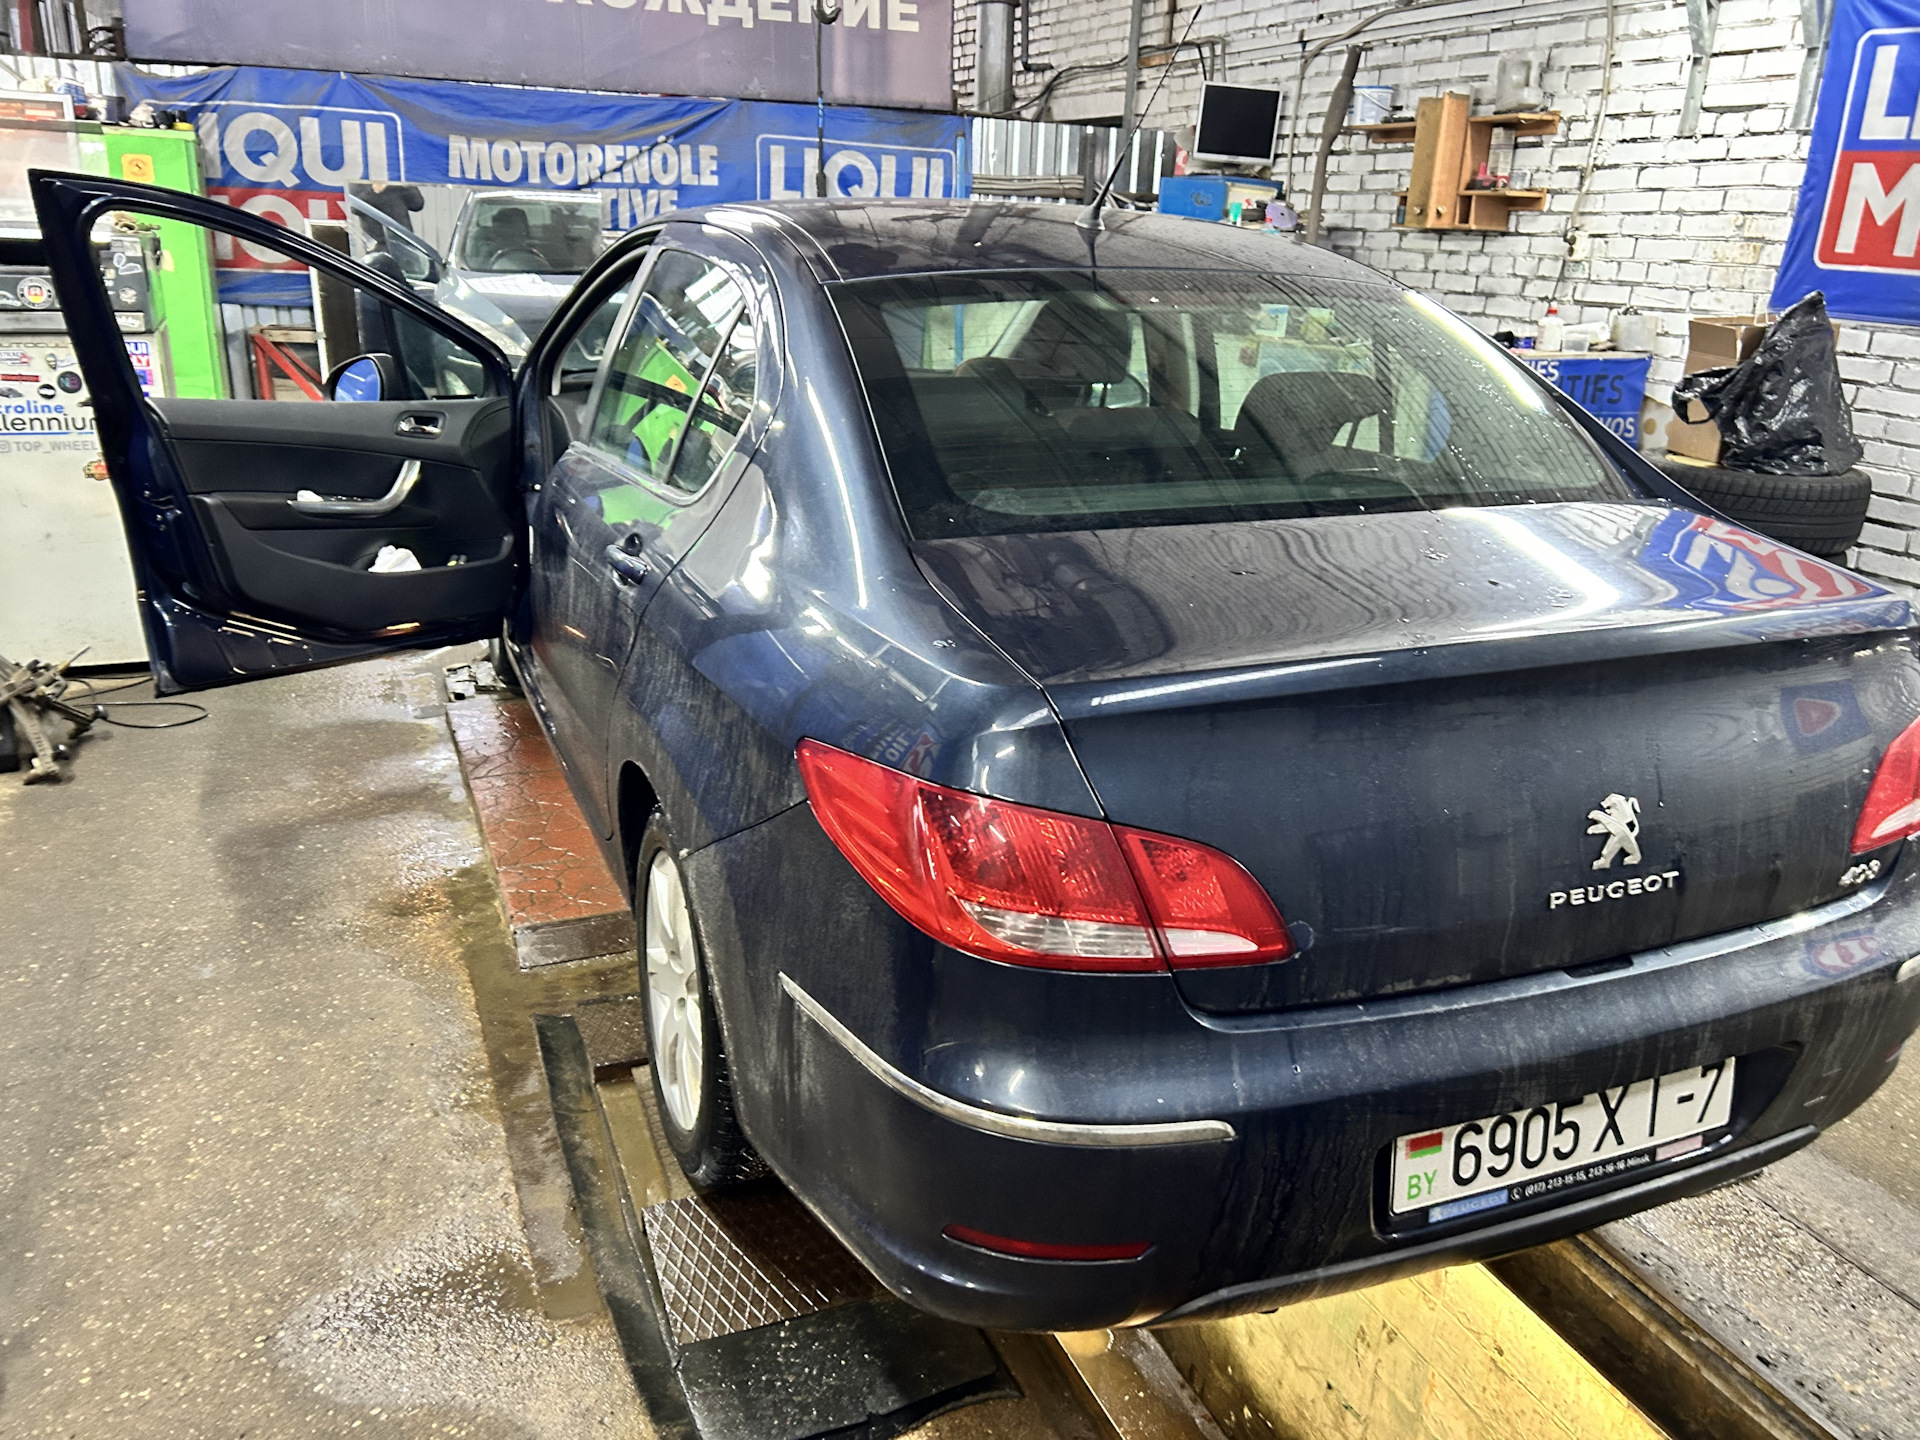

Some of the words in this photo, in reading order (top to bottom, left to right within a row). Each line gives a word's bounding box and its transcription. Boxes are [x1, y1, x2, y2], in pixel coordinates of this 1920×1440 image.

[1859, 45, 1920, 139] L
[449, 134, 719, 186] MOTORENÖLE
[581, 187, 678, 229] TIVE
[0, 400, 64, 414] roline
[0, 413, 96, 431] lenniu
[1549, 870, 1680, 910] PEUGEOT
[1407, 1169, 1437, 1200] BY
